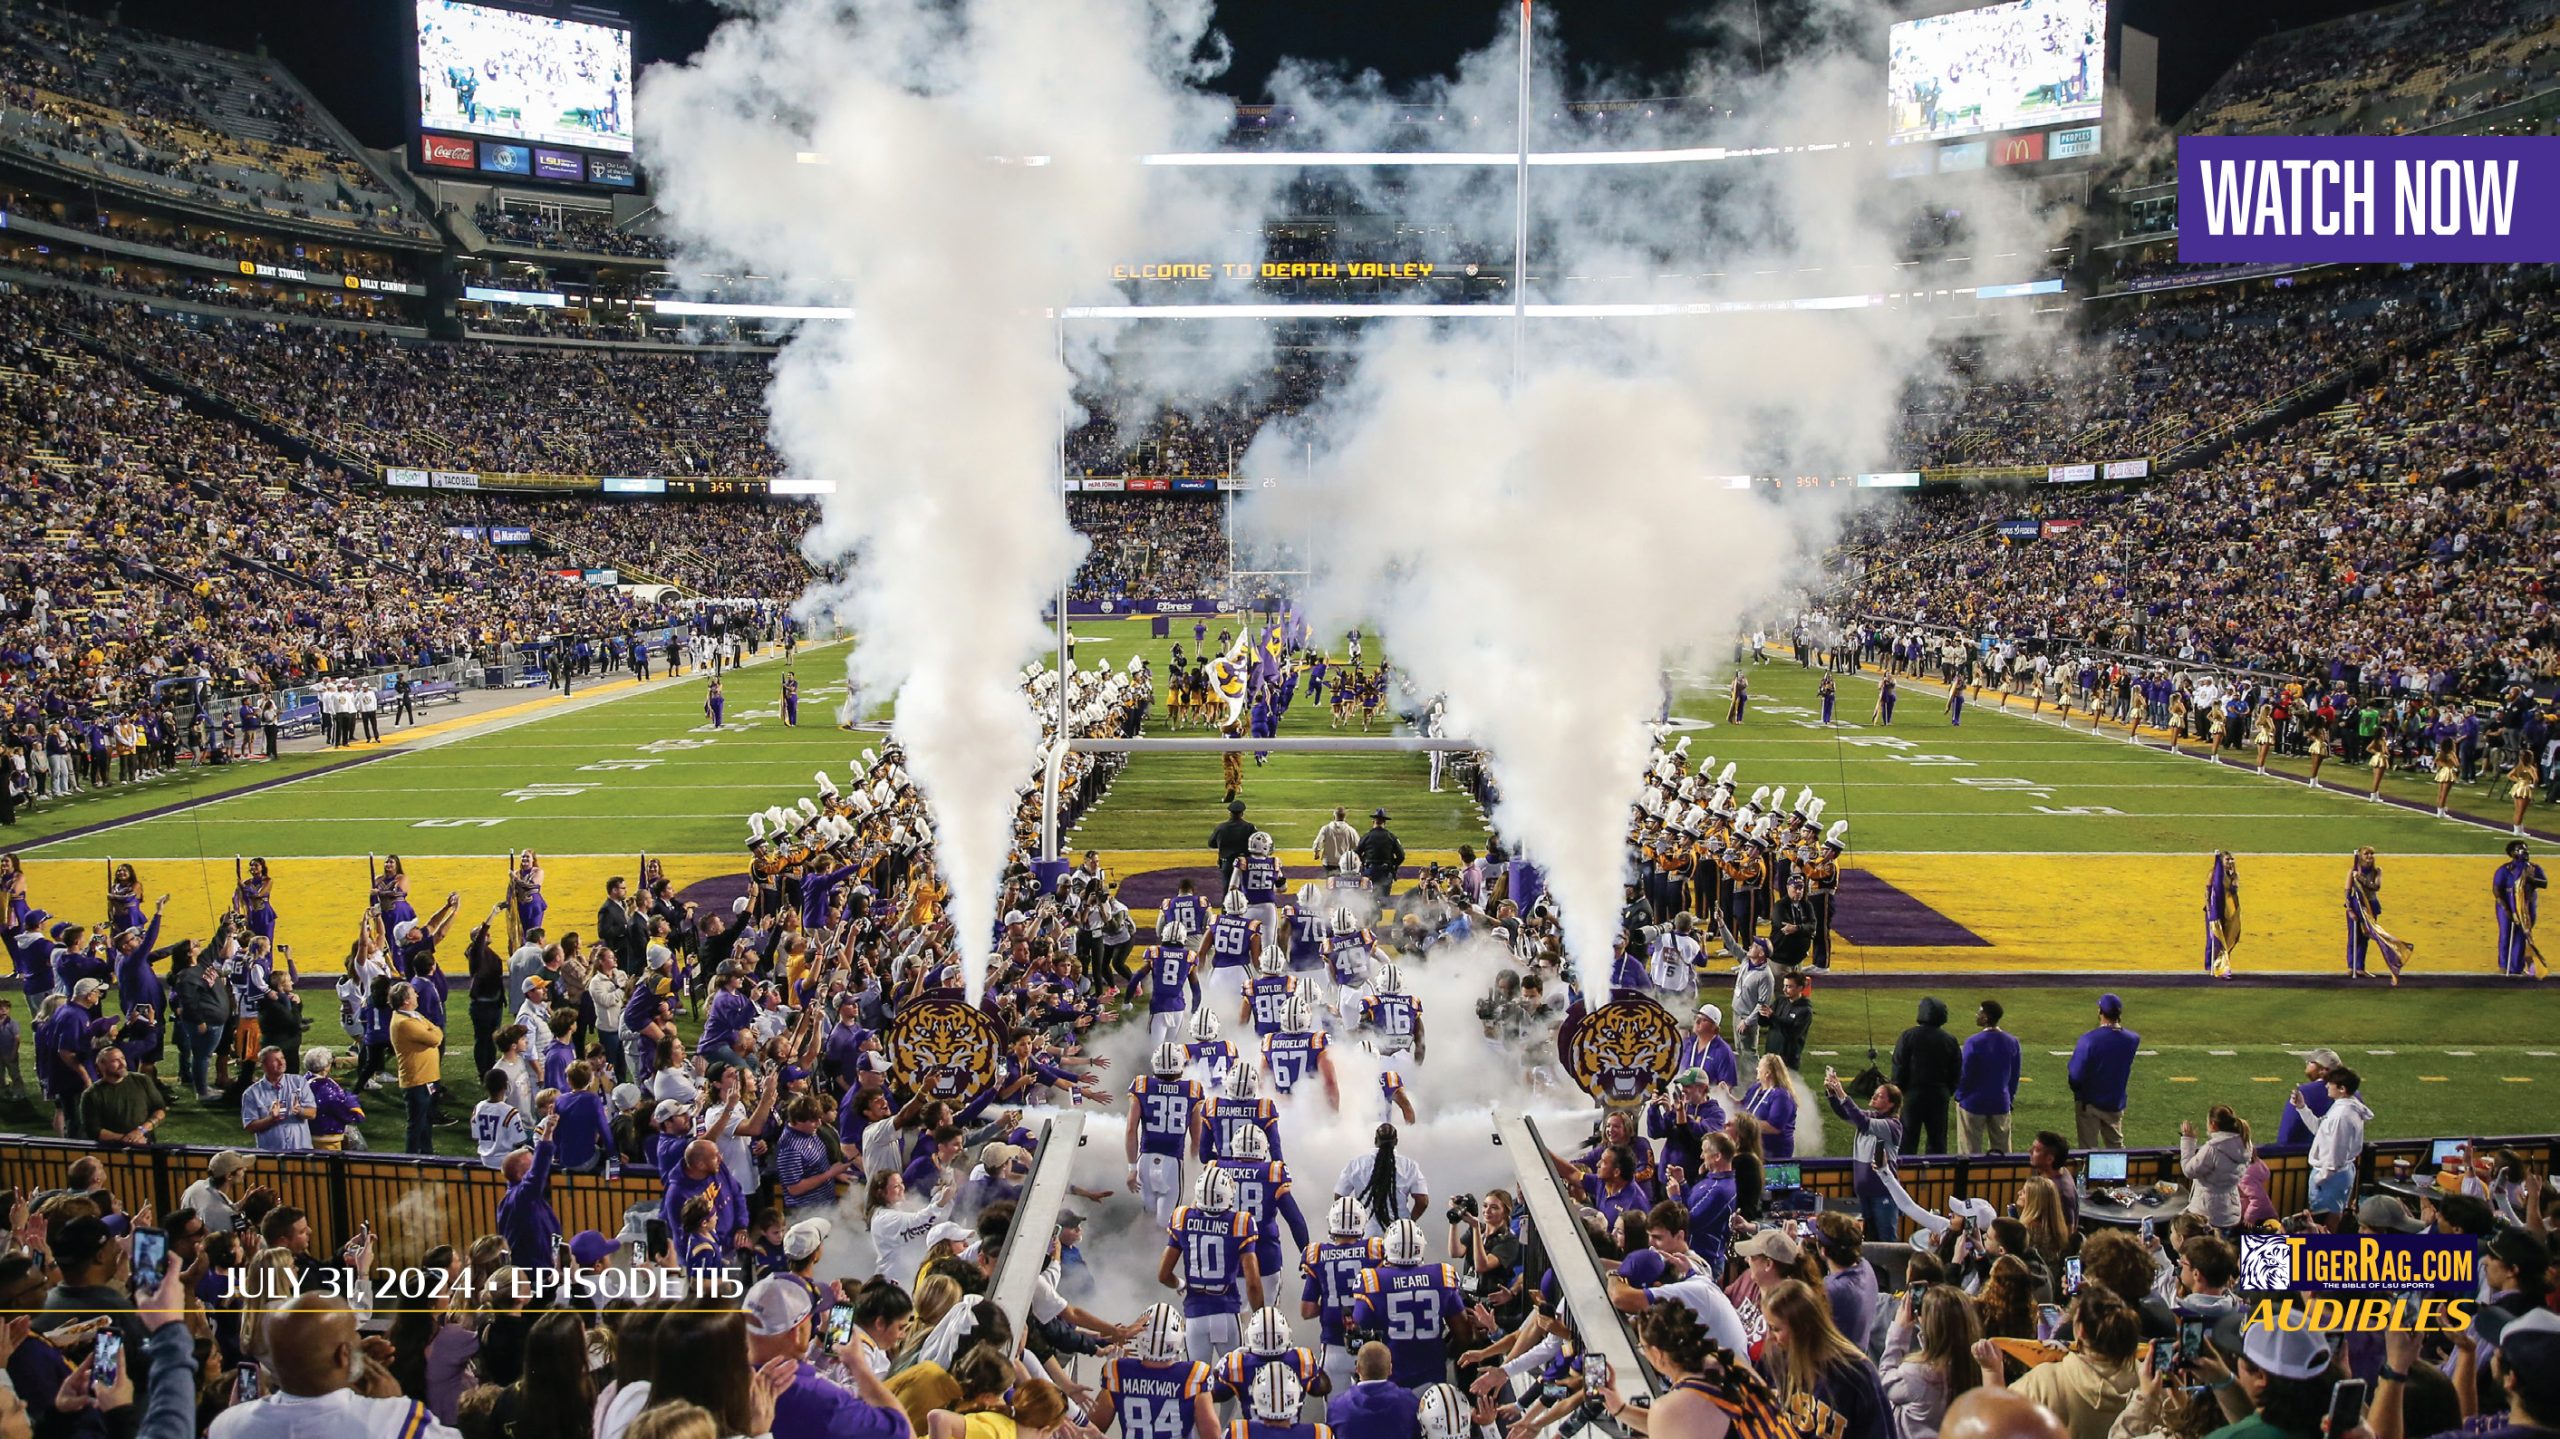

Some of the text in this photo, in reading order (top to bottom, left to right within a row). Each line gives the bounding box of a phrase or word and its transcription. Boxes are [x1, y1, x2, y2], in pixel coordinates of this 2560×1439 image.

[256, 264, 276, 276] JERRY
[1223, 264, 1253, 278] TO
[1261, 264, 1338, 278] DEATH
[1347, 264, 1434, 278] VALLEY
[360, 278, 379, 290] BILLY
[380, 280, 407, 293] CANNON
[444, 476, 476, 486] TACO BELL
[710, 482, 732, 493] 3:59
[1262, 478, 1276, 488] 25
[1796, 476, 1819, 487] 3:59
[501, 530, 530, 542] Marathon
[1248, 871, 1274, 890] 66
[1175, 900, 1194, 908] WINGO
[1174, 908, 1196, 932] 18
[1298, 916, 1326, 943] 70
[1214, 924, 1246, 955] 69
[1163, 951, 1184, 960] BURNS
[1162, 960, 1180, 986] 8
[1257, 985, 1283, 994] TAYLOR
[373, 1008, 381, 1030] 1
[1384, 1004, 1411, 1035] 16
[1200, 1046, 1217, 1055] ROY
[1271, 1038, 1310, 1049] BORDELON
[1272, 1050, 1308, 1090] 67
[1158, 1084, 1179, 1094] TODD
[1146, 1096, 1188, 1134] 38
[1216, 1106, 1258, 1118] BRAMBLETT
[478, 1114, 500, 1142] 27
[1186, 1218, 1230, 1234] COLLINS
[1188, 1234, 1225, 1280] 10
[1320, 1246, 1366, 1262] NUSSMEIER
[1324, 1260, 1362, 1307] 13
[1392, 1274, 1430, 1290] HEARD
[1386, 1290, 1441, 1340] 53
[1122, 1378, 1182, 1398] MARKWAY
[1123, 1396, 1184, 1439] 84
[1784, 1391, 1848, 1439] SU
